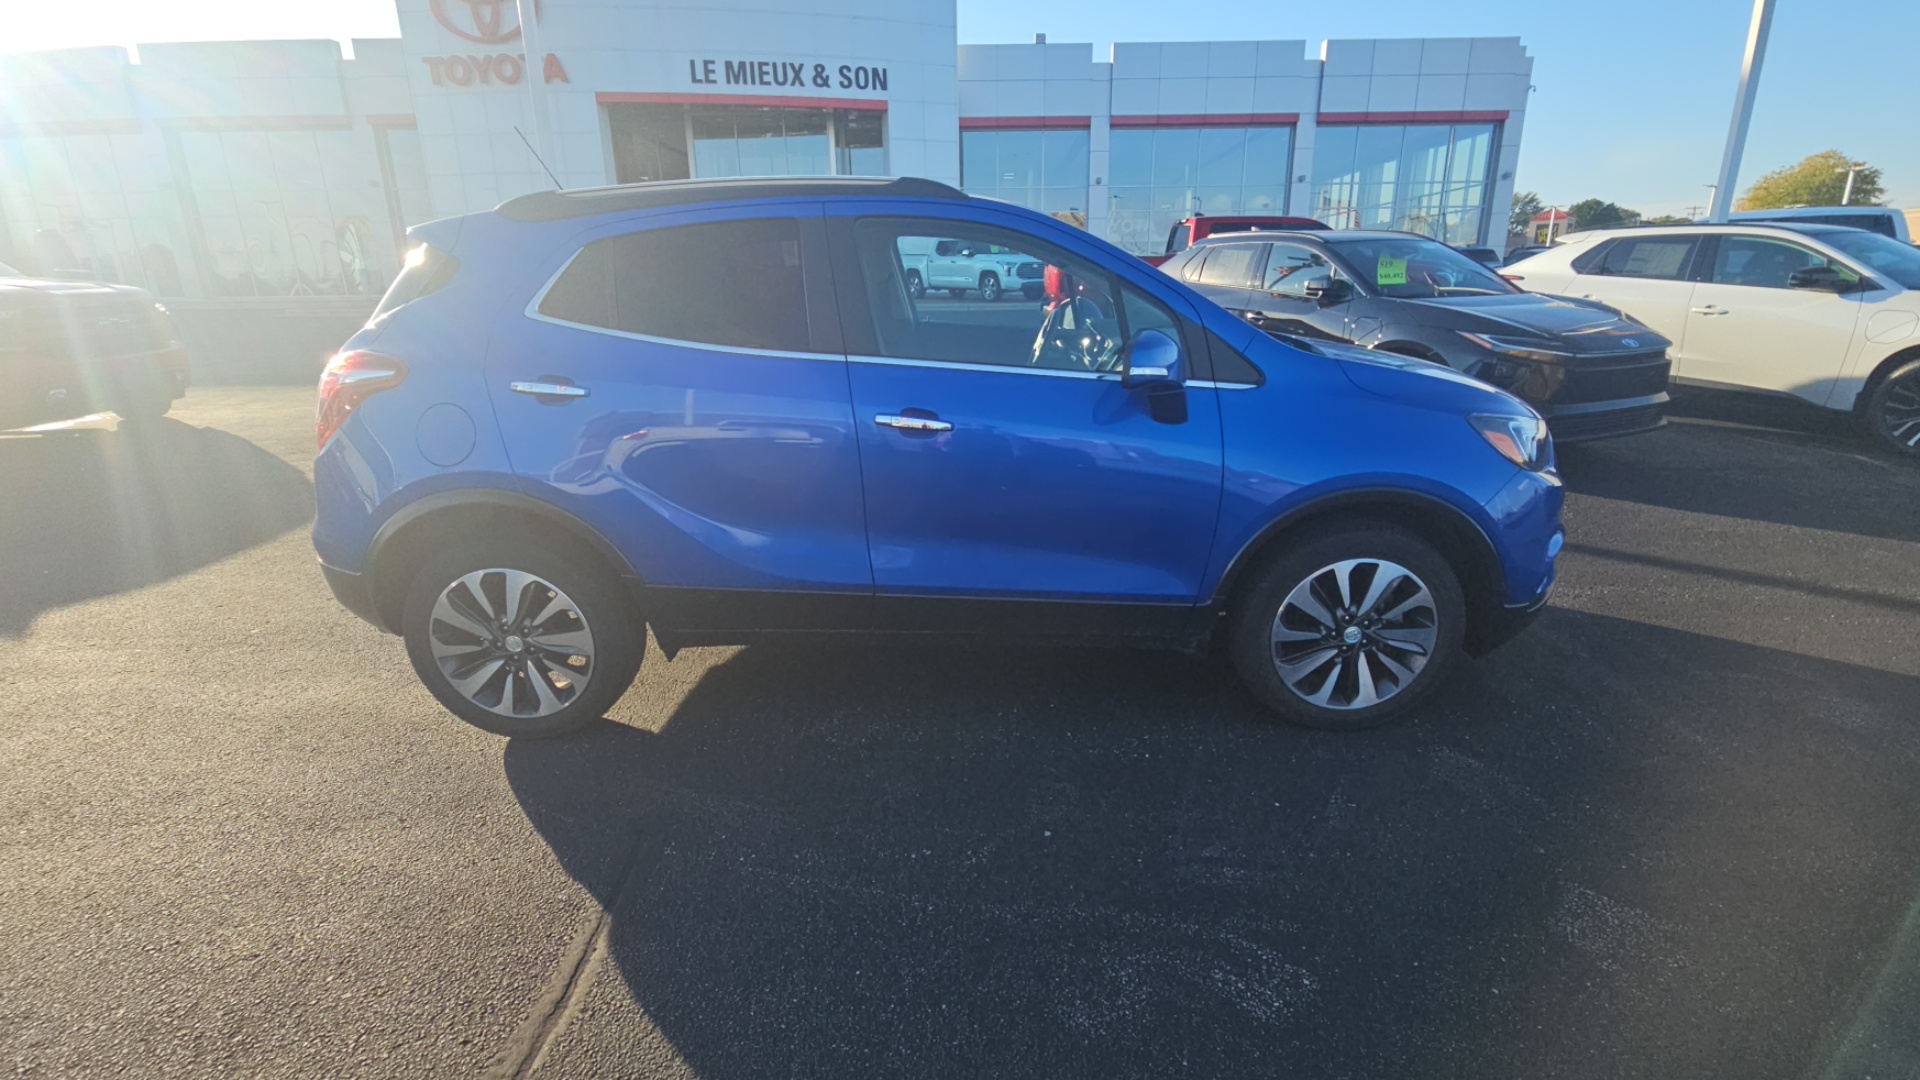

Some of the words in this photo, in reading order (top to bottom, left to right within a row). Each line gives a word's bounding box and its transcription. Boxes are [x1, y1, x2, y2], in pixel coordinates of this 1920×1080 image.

[421, 53, 568, 87] TOYOA
[690, 59, 717, 84] LE
[724, 60, 805, 87] MIEUX
[812, 63, 831, 88] &
[838, 65, 888, 91] SON
